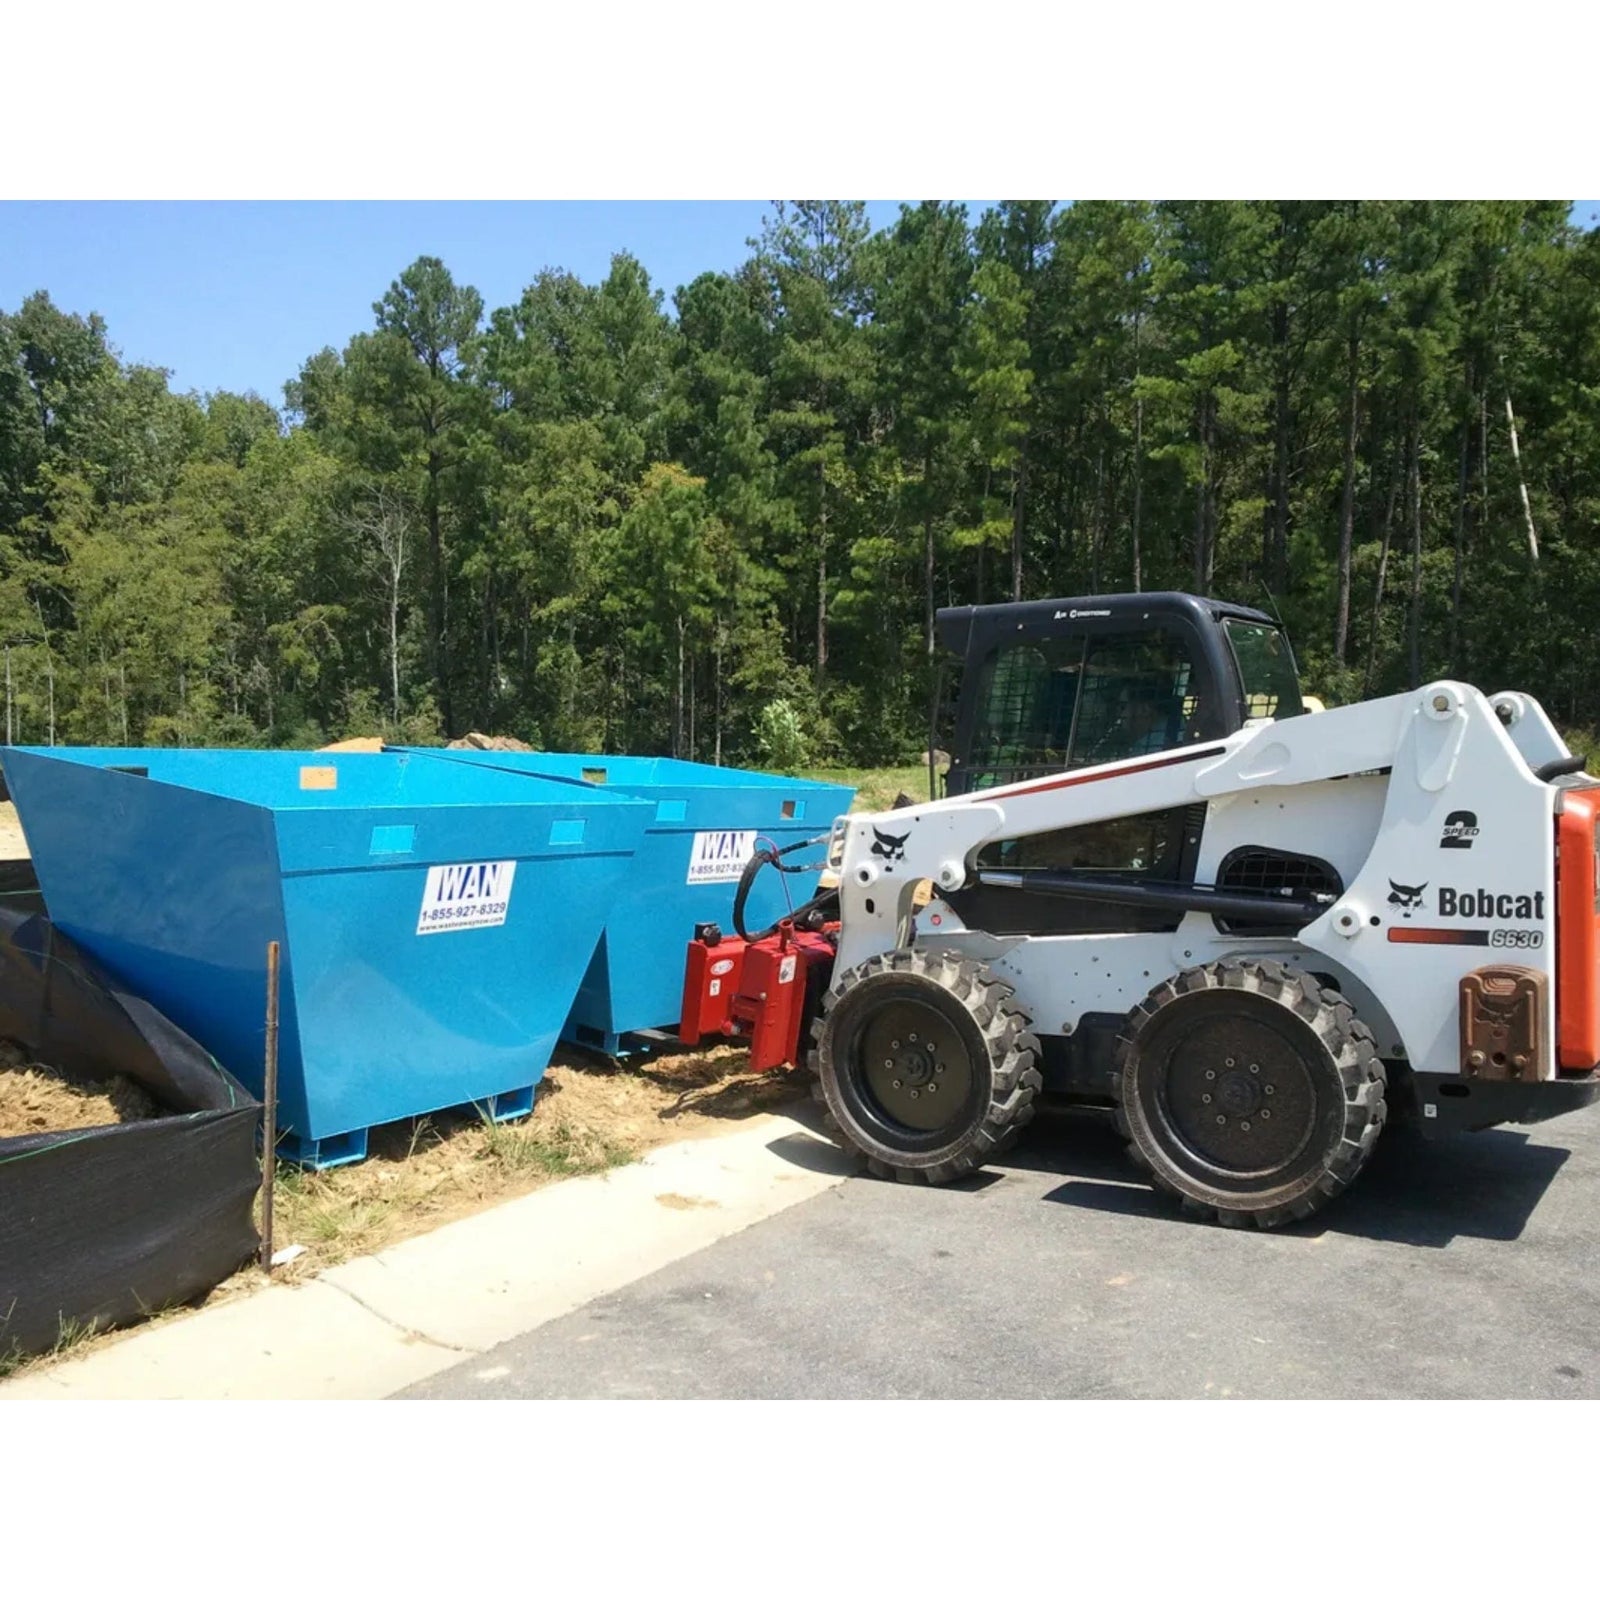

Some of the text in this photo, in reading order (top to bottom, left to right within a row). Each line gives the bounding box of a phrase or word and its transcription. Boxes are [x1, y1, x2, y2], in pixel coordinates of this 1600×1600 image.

[1440, 810, 1478, 849] 2
[1442, 827, 1480, 836] SPEED
[701, 833, 748, 859] WAN
[437, 864, 504, 902] WAN
[422, 902, 507, 921] 1-855-927-8329
[1438, 887, 1544, 919] Bobcat
[1491, 929, 1543, 949] S630
